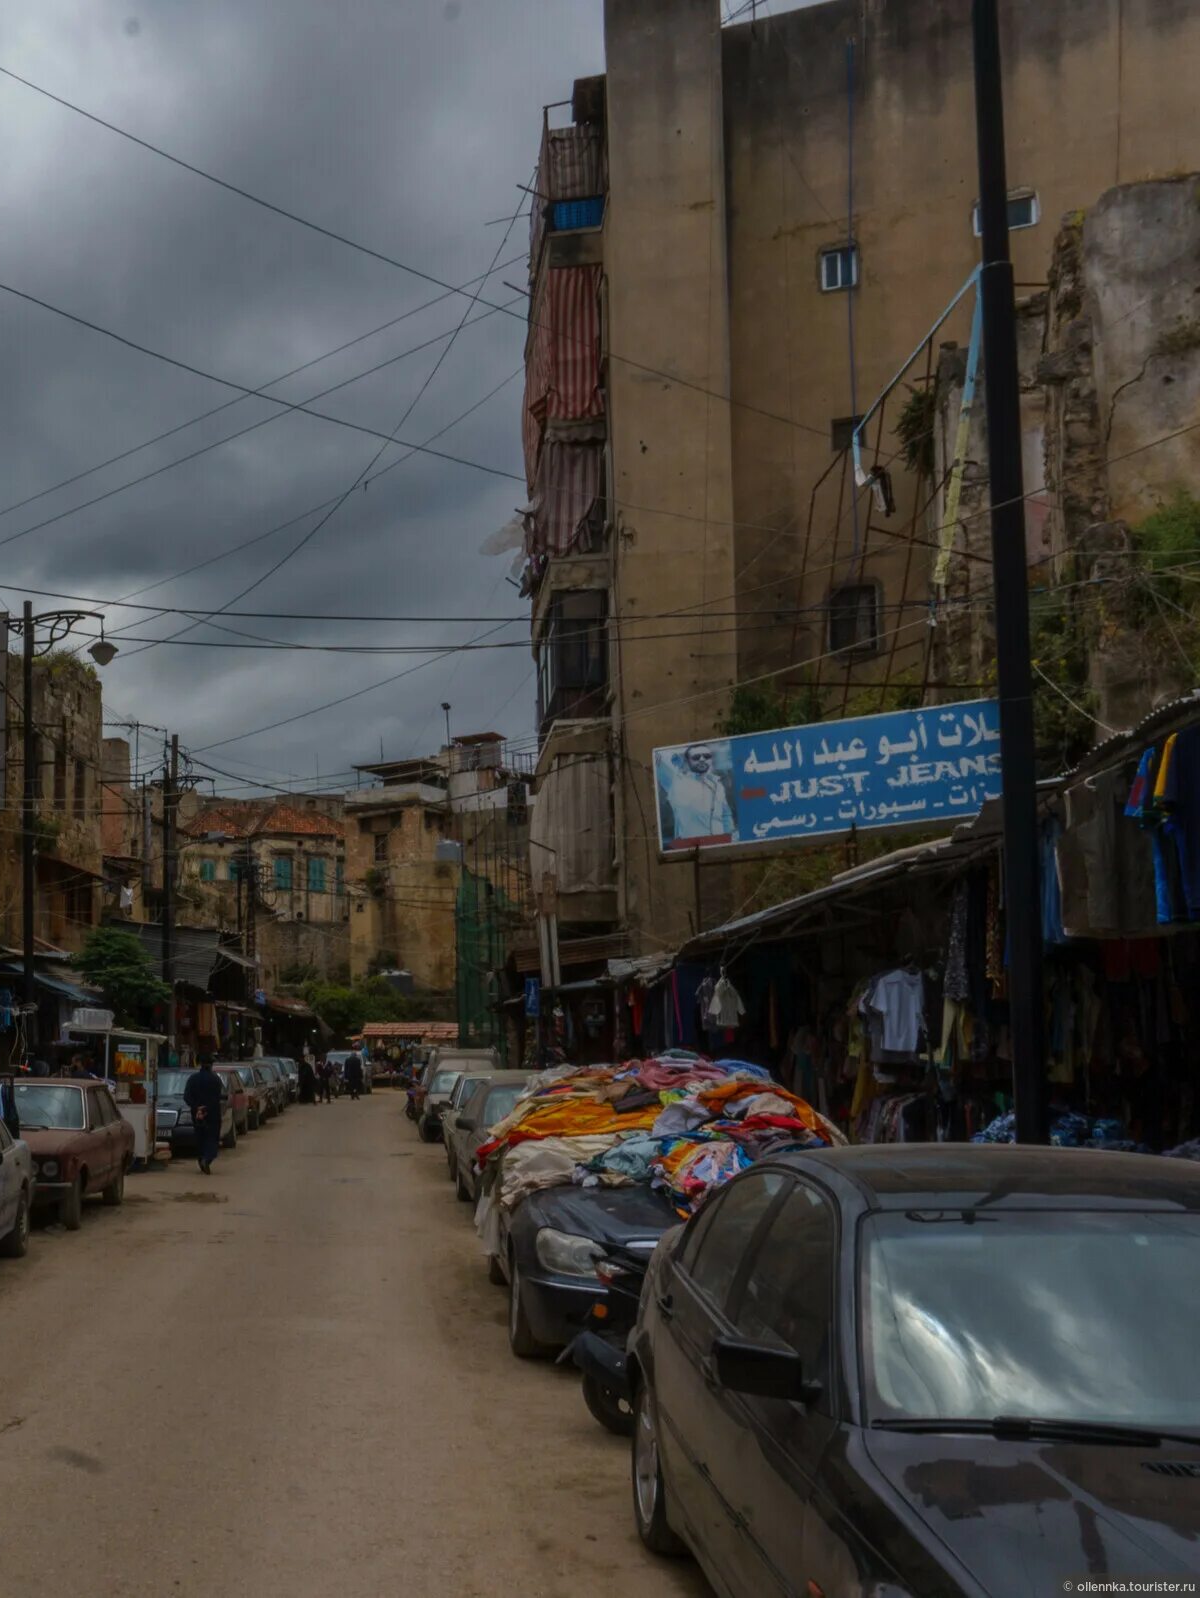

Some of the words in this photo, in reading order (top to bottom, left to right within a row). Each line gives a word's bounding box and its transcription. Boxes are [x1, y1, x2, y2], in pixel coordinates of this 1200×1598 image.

[876, 714, 927, 765] أبو
[937, 711, 1001, 748] لات
[743, 739, 803, 774] الله
[813, 737, 868, 771] عبد
[769, 771, 870, 804] JUST
[752, 811, 818, 838] رسمي
